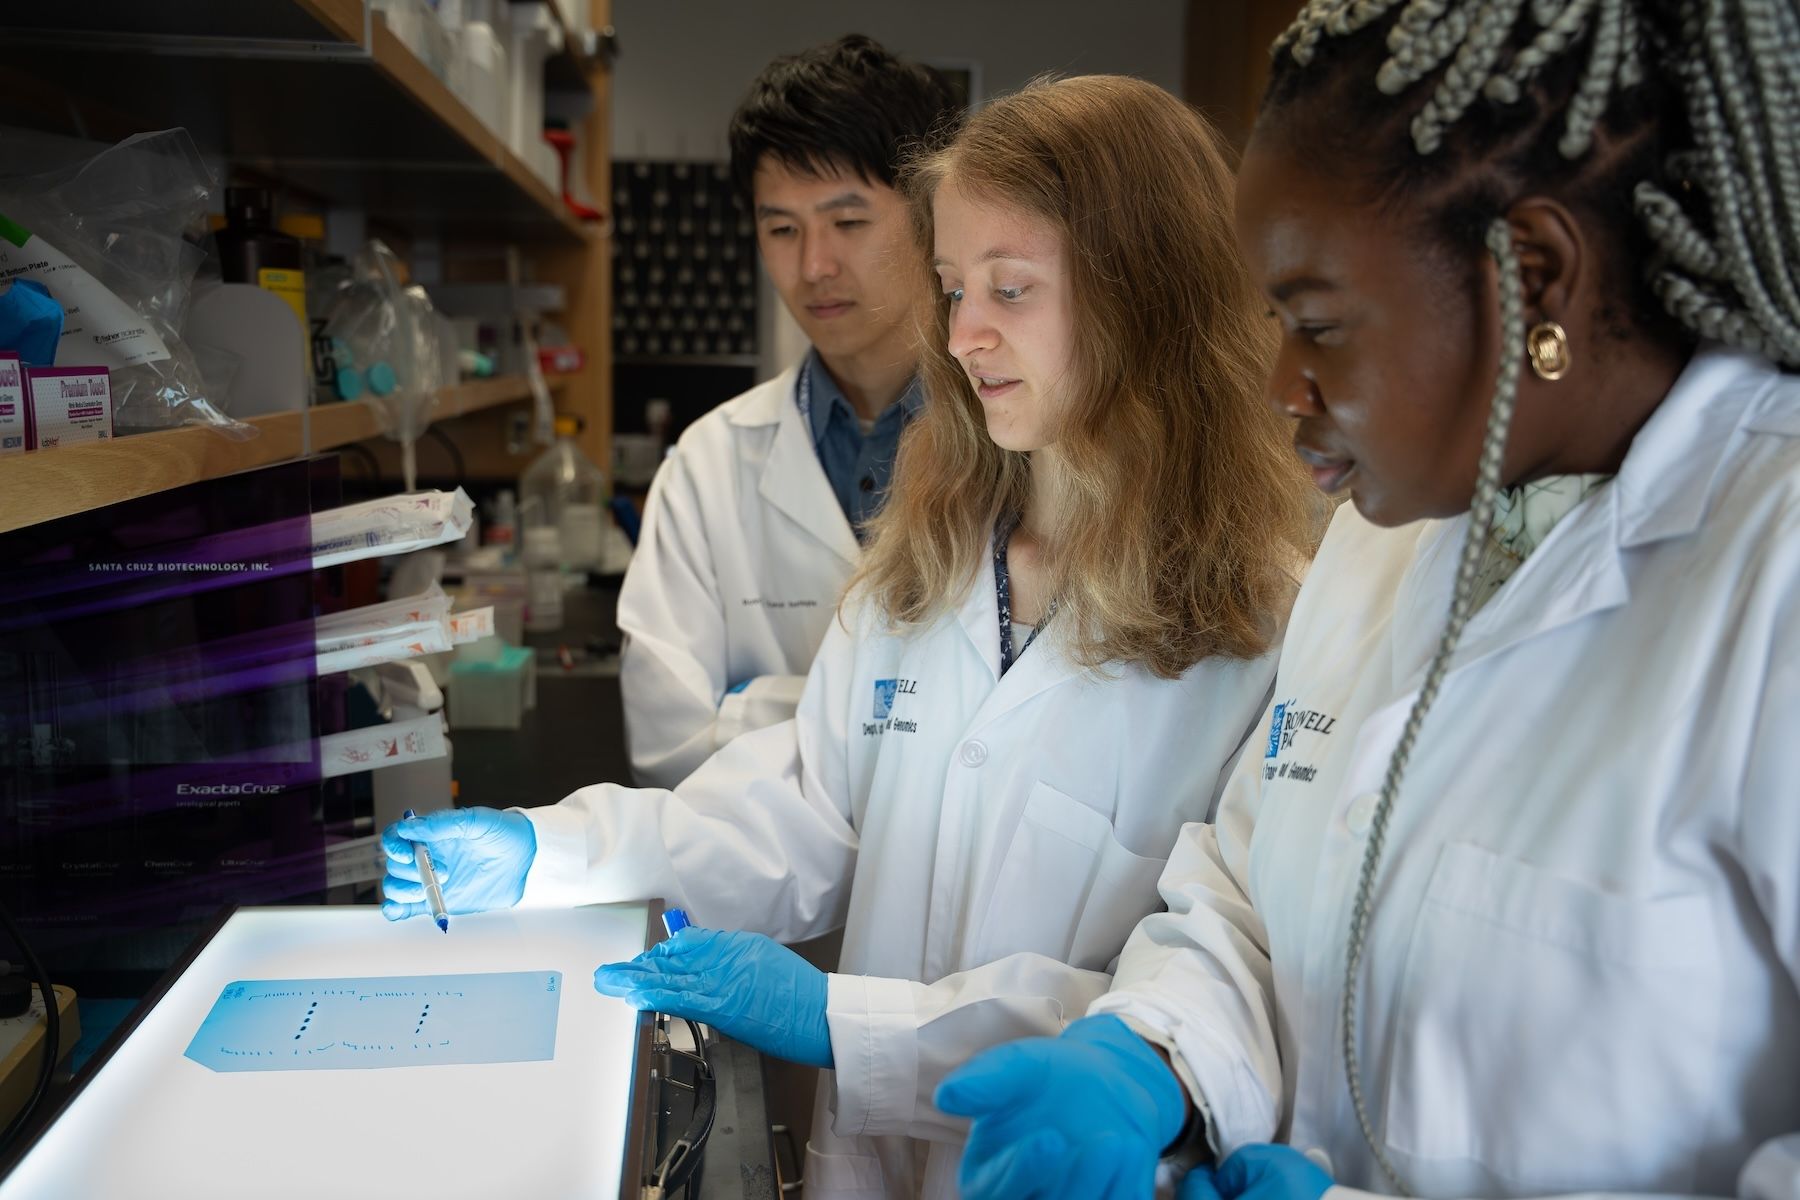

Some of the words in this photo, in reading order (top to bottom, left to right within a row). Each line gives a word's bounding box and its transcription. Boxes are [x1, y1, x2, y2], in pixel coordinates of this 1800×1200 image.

[88, 562, 123, 572] SANTA
[126, 562, 154, 572] CRUZ
[157, 562, 248, 572] BIOTECHNOLOGY,
[251, 562, 273, 572] INC.
